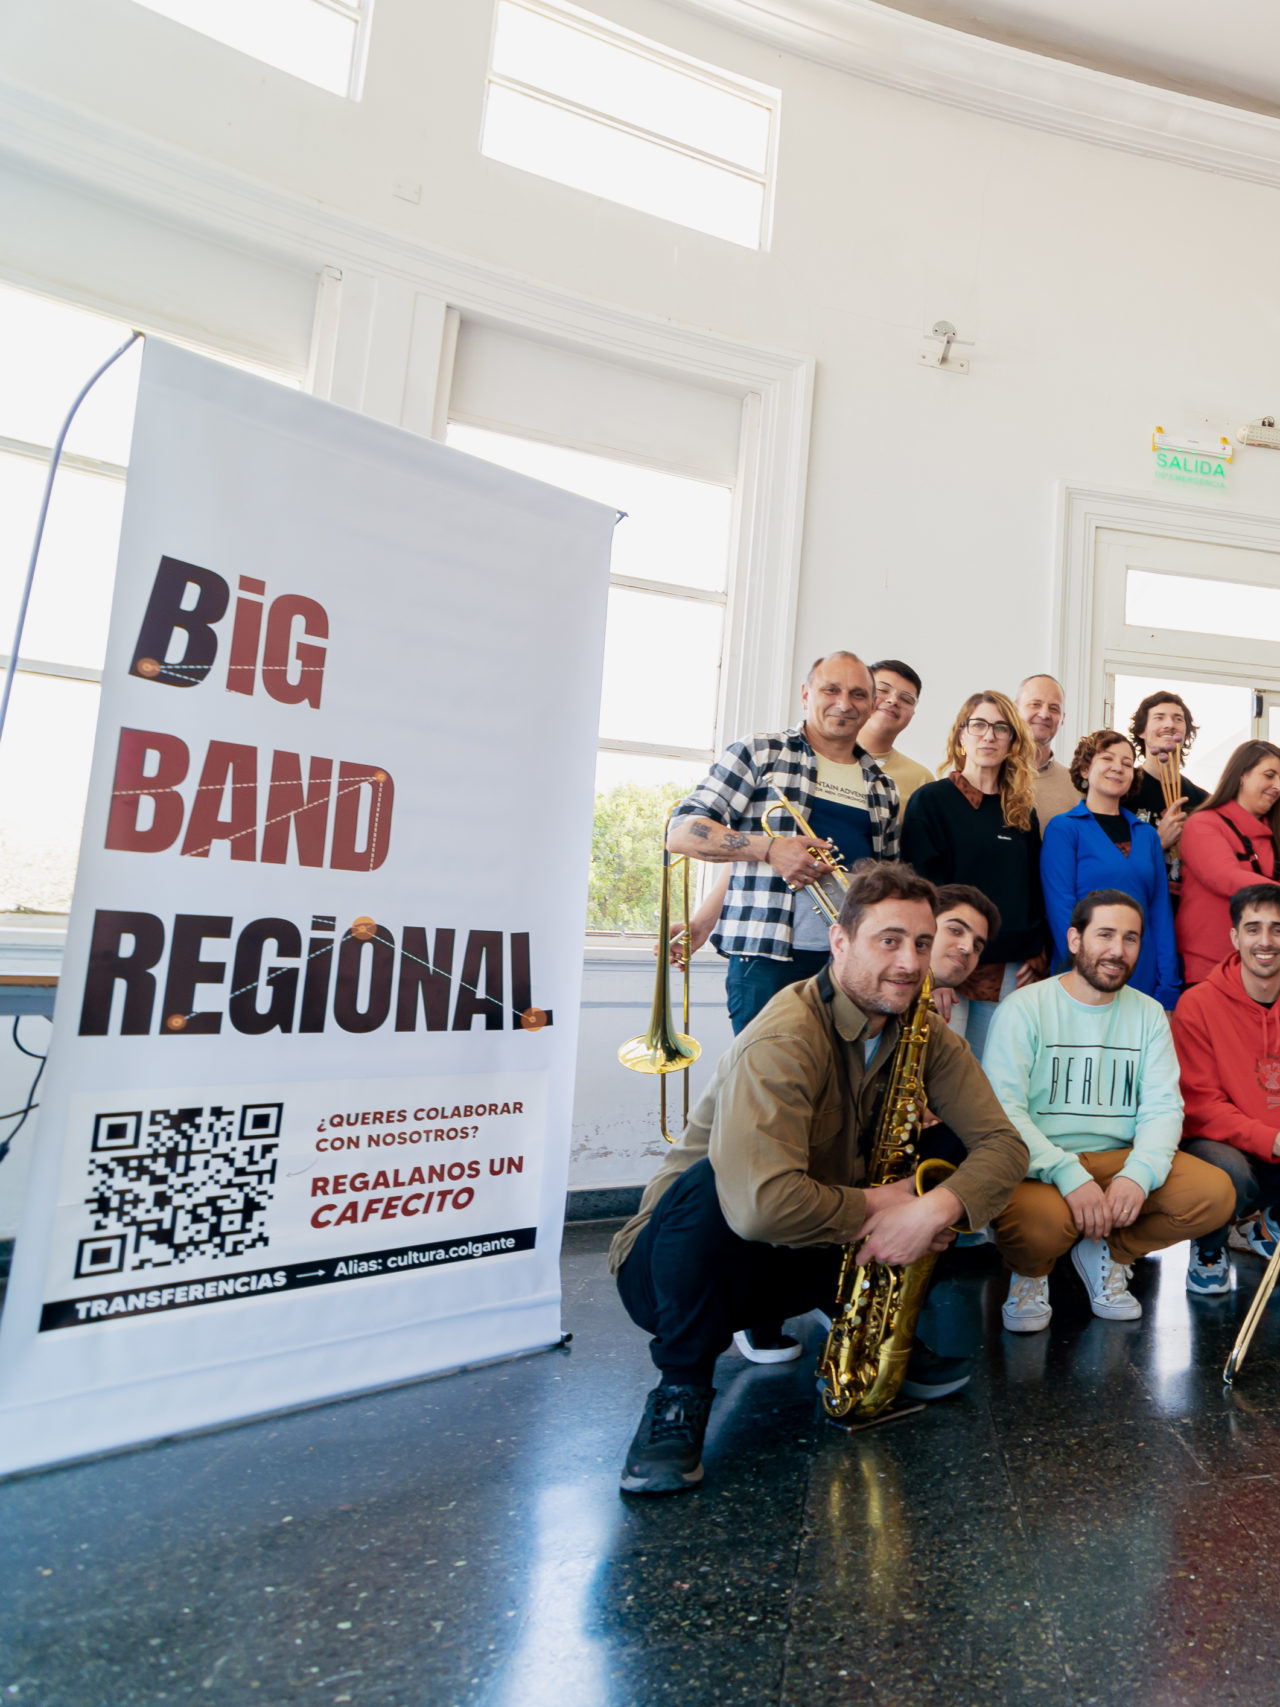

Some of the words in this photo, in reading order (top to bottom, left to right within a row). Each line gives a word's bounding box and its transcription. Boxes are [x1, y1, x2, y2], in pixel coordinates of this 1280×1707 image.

[1156, 452, 1226, 478] SALIDA
[104, 726, 395, 873] BAND
[1048, 1056, 1134, 1108] BERLIN
[316, 1109, 408, 1133] ¿QUERES
[413, 1101, 524, 1122] COLABORAR
[315, 1136, 361, 1153] CON
[367, 1125, 480, 1148] NOSOTROS?
[310, 1160, 482, 1198] REGALANOS
[488, 1155, 525, 1177] UN
[310, 1186, 476, 1230] CAFECITO
[75, 1270, 288, 1321] TRANSFERENCIAS
[333, 1257, 383, 1278] Alias:
[386, 1236, 516, 1269] cultura.colgante
